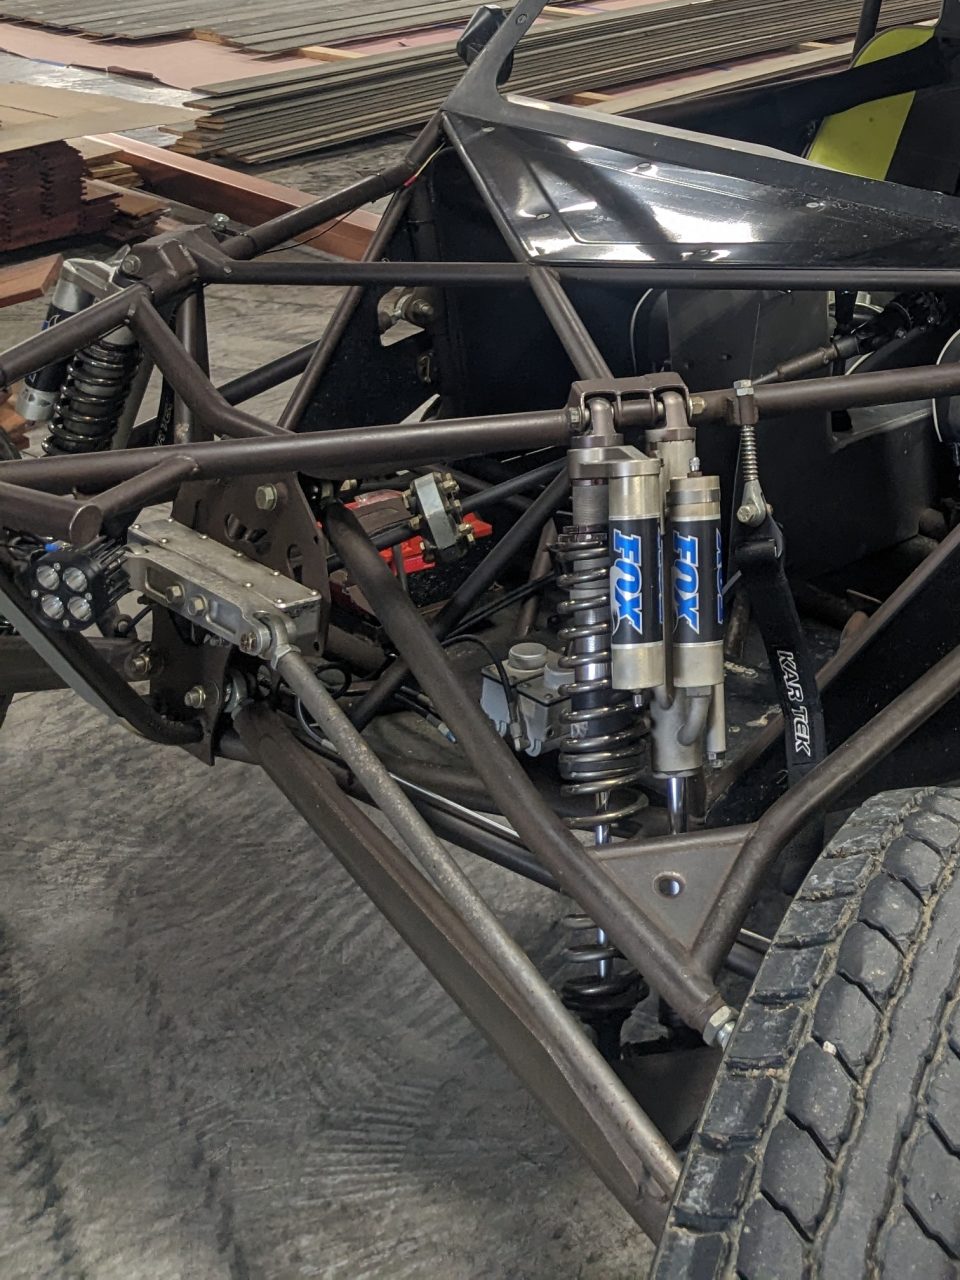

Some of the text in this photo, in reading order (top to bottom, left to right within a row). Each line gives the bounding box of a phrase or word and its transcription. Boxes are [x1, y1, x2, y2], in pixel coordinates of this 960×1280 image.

[612, 528, 643, 636] FOX
[672, 530, 700, 636] FOX
[776, 649, 811, 757] KAR TEK
